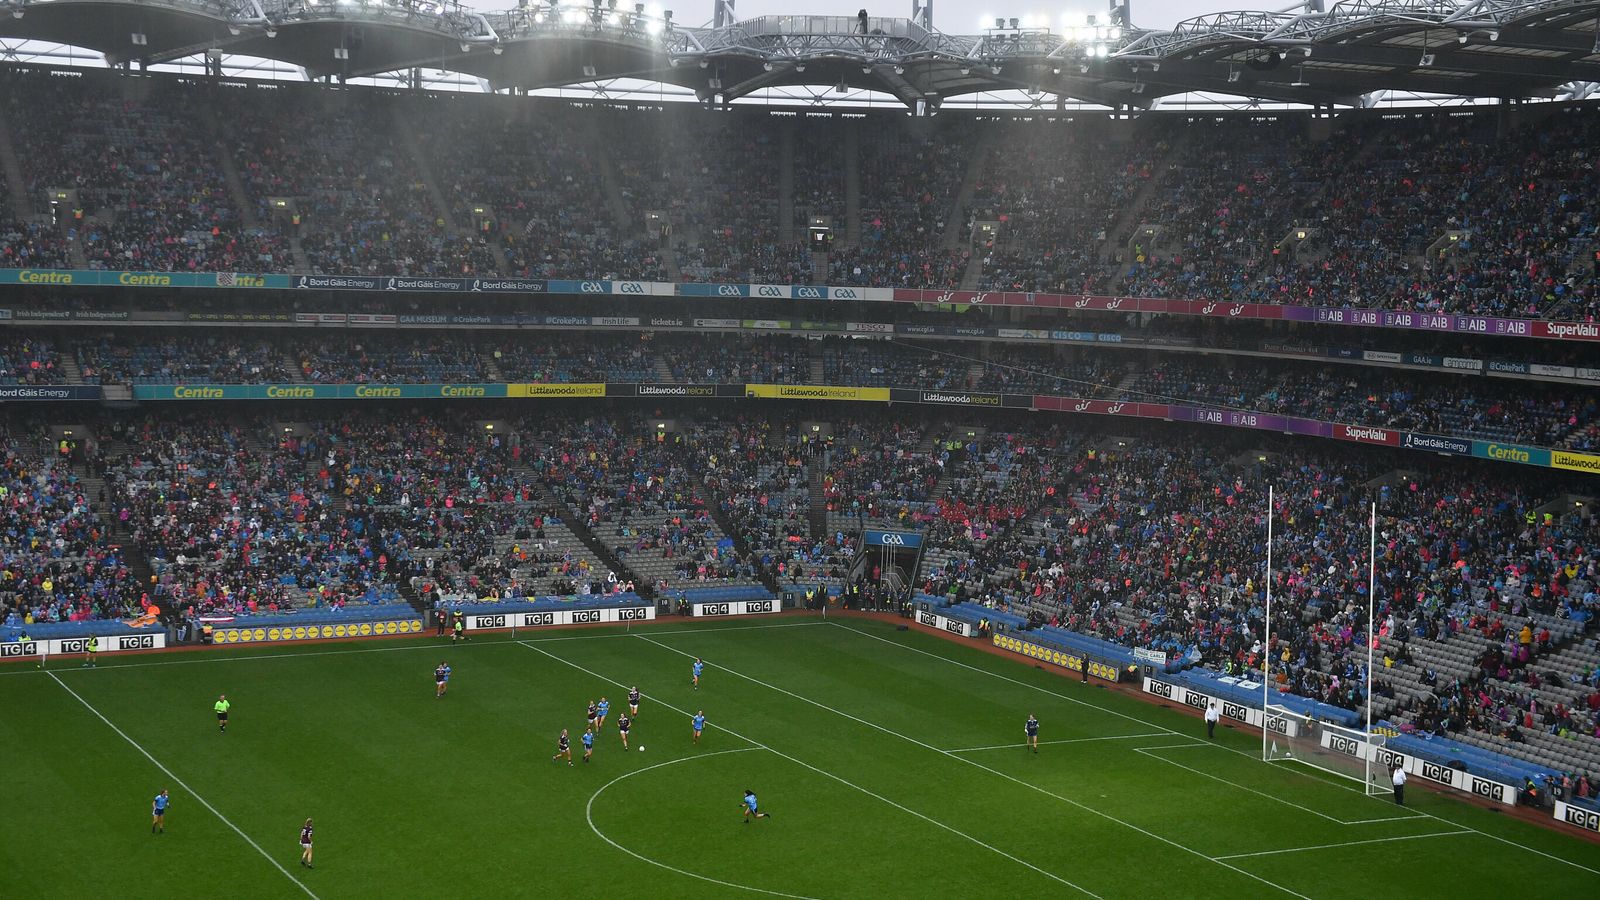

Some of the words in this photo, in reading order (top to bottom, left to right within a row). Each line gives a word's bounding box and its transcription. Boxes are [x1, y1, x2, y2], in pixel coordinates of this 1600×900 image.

[19, 271, 72, 283] Centra
[120, 272, 171, 285] Centra
[347, 280, 375, 288] Energy
[434, 282, 460, 290] Energy
[517, 283, 543, 291] Energy
[1328, 311, 1343, 322] AIB
[1361, 313, 1377, 323] AIB
[1395, 315, 1412, 326] AIB
[1430, 317, 1448, 328] AIB
[1469, 319, 1486, 330] AIB
[1507, 322, 1526, 333] AIB
[1547, 323, 1599, 337] SuperValu
[39, 389, 70, 398] Energy
[174, 386, 224, 398] Centra
[267, 386, 315, 397] Centra
[355, 385, 401, 397] Centra
[441, 385, 485, 397] Centra
[1207, 412, 1223, 422] AIB
[1240, 415, 1257, 426] AIB
[1345, 426, 1386, 441] SuperValu
[1413, 437, 1430, 446] Bord
[1444, 441, 1468, 452] Energy
[1487, 444, 1529, 462] Centra
